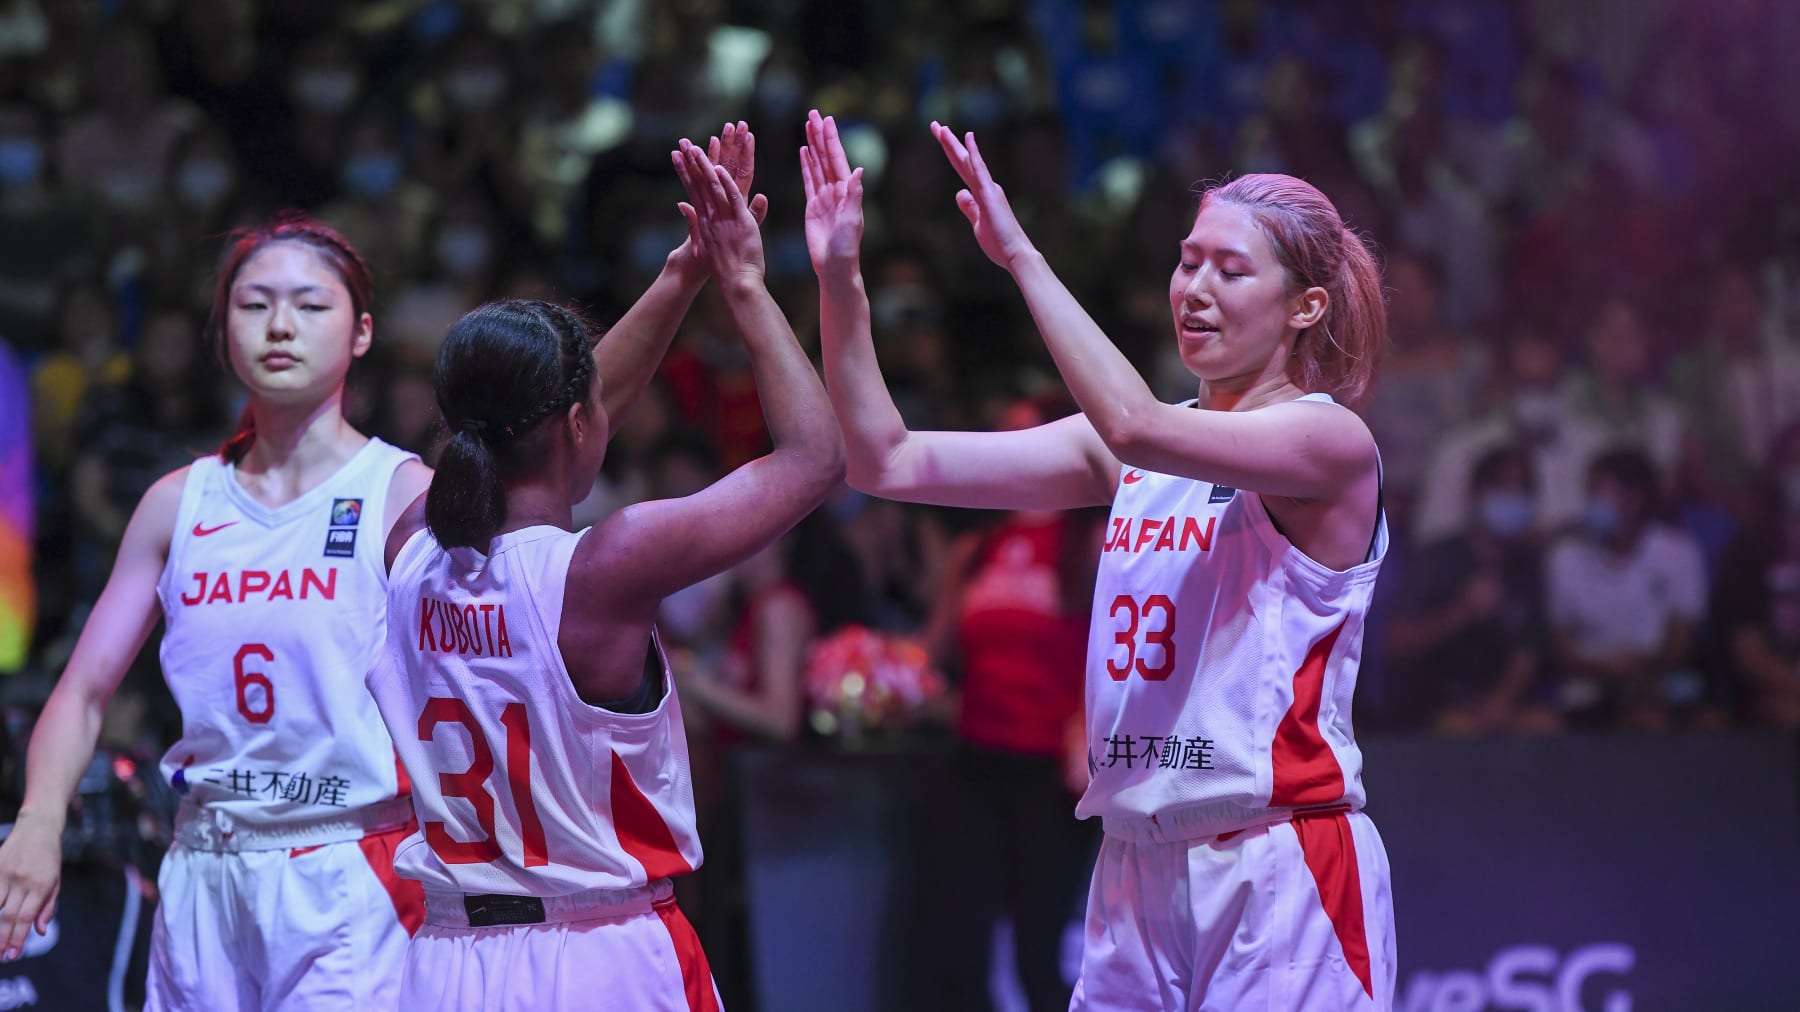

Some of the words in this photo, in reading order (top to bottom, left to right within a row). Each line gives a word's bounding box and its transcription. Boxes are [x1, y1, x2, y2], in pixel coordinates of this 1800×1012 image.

[181, 567, 337, 606] JAPAN
[419, 597, 513, 658] KUBOTA
[1107, 595, 1176, 681] 33
[233, 643, 275, 724] 6
[418, 697, 549, 869] 31
